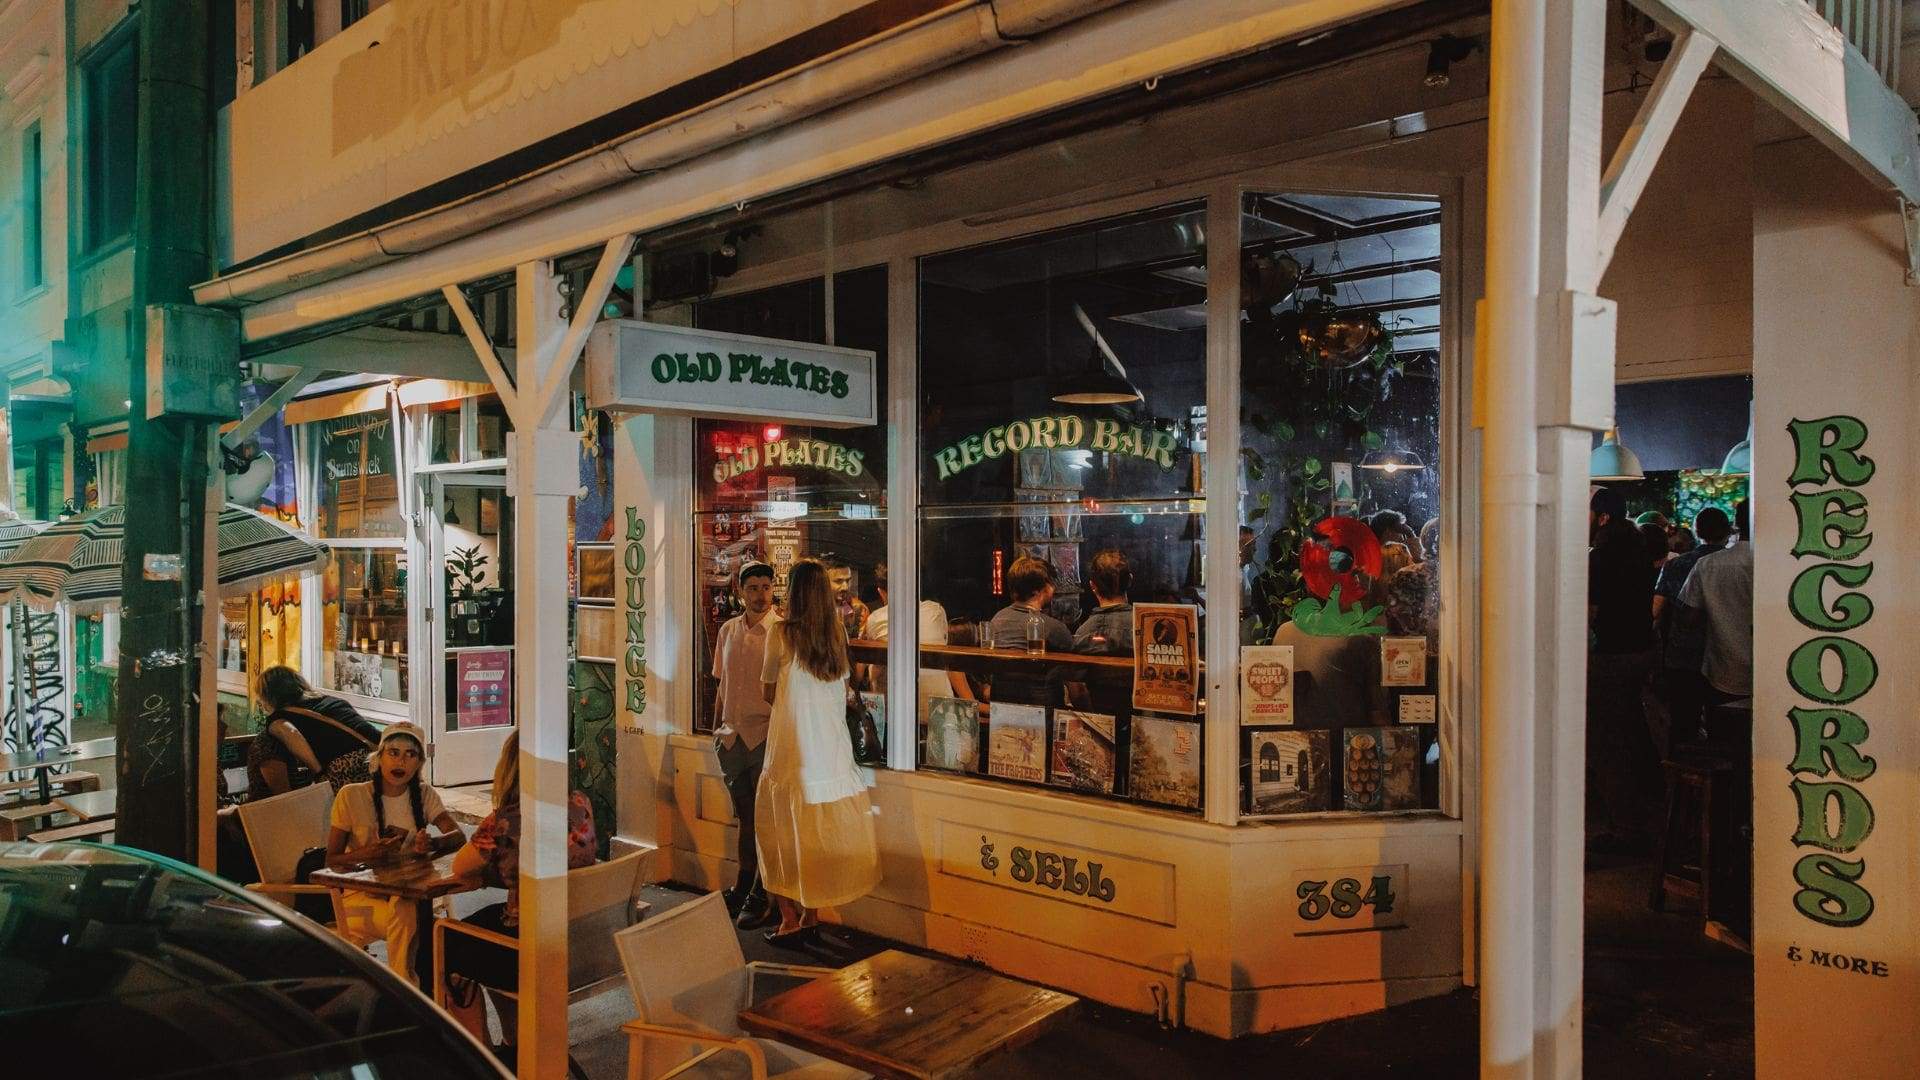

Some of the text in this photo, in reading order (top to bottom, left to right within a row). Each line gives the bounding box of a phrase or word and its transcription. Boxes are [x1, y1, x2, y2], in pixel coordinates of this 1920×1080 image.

[650, 352, 849, 398] OLD PLATES
[713, 439, 865, 483] OLD PLATES
[934, 415, 1179, 480] RECORD BAR
[624, 507, 646, 714] LOUNGE
[1148, 645, 1183, 655] SABAR
[1250, 667, 1282, 676] SWEET
[1785, 414, 1878, 928] RECORDS
[1249, 675, 1285, 684] PEOPLE
[1010, 847, 1116, 904] SELL
[1295, 875, 1396, 921] 384
[1786, 940, 1889, 978] & MORE
